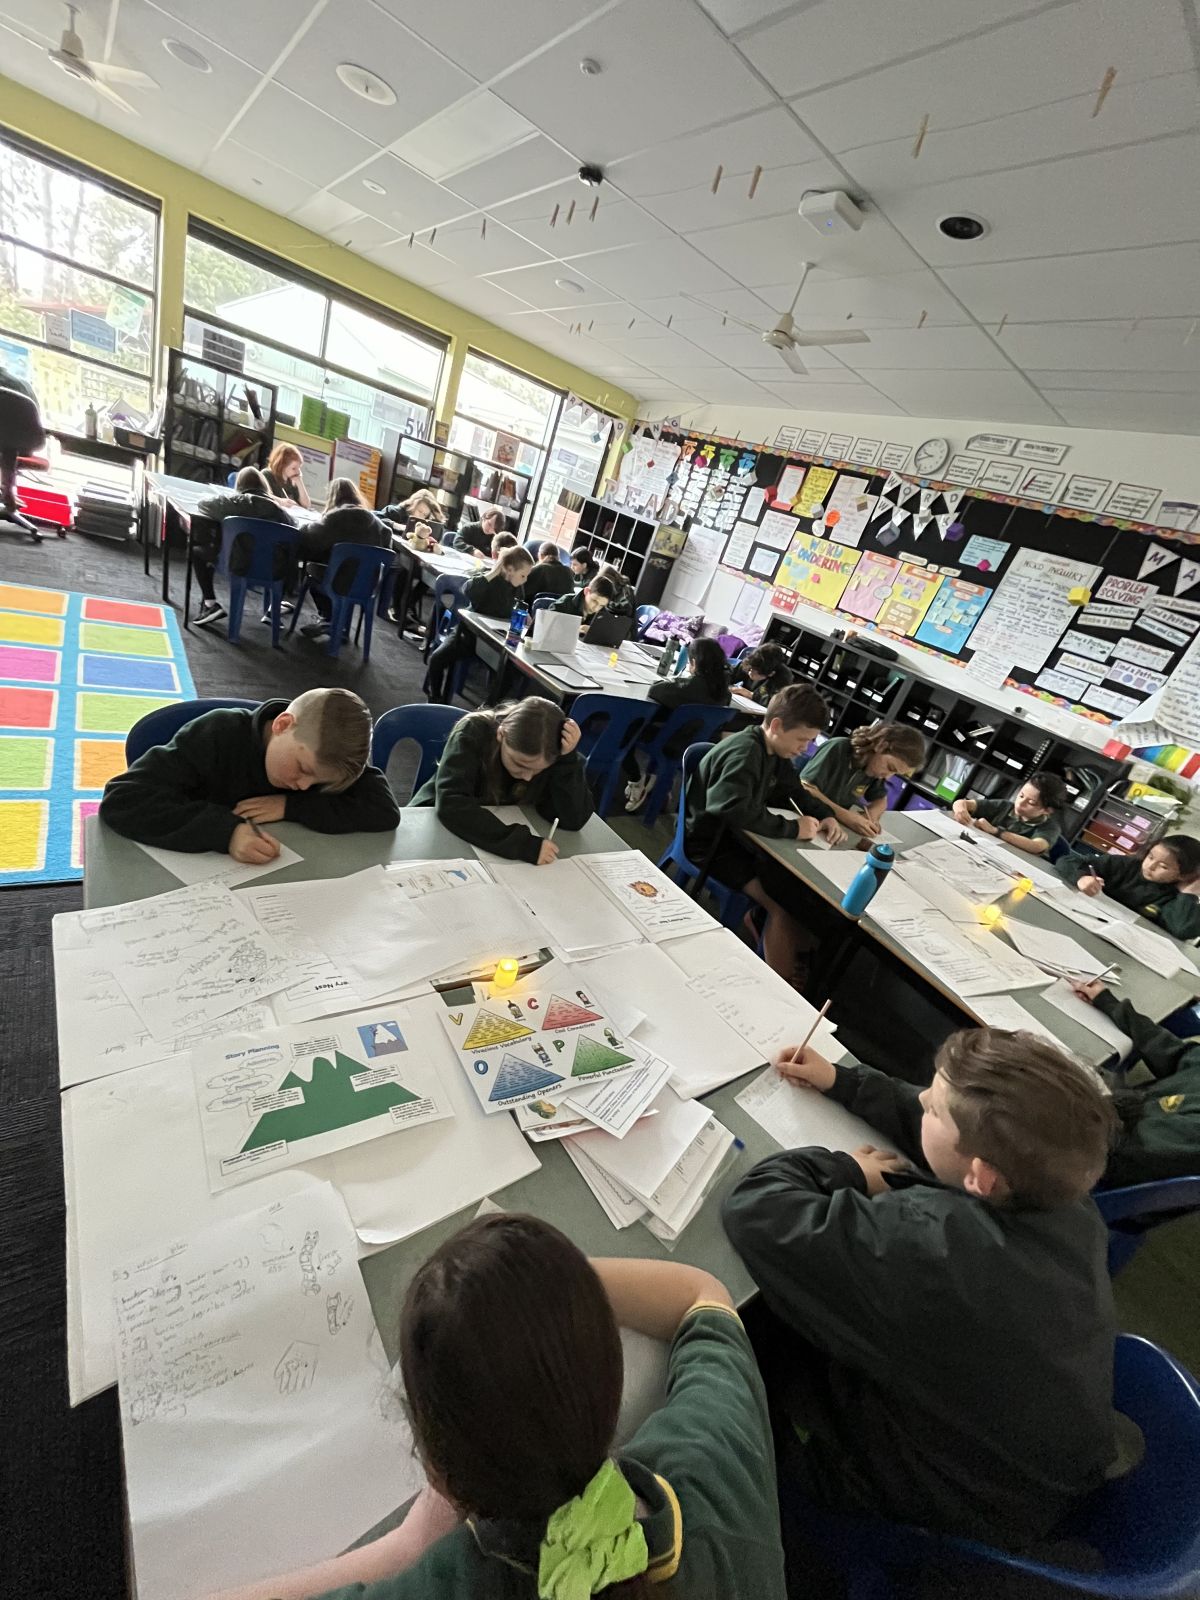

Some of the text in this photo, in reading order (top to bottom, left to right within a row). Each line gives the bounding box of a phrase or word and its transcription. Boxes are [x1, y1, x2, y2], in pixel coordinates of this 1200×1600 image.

[1105, 576, 1149, 596] PROBLEM
[1099, 587, 1143, 605] SOLVING
[1166, 614, 1196, 630] Pattern
[1135, 669, 1163, 683] Pattern
[526, 997, 540, 1010] C
[448, 1012, 464, 1026] V
[225, 1050, 246, 1060] Story
[247, 1043, 280, 1055] Planning
[552, 1039, 565, 1053] P
[473, 1059, 489, 1075] O
[578, 1073, 602, 1082] Powerful
[497, 1083, 563, 1106] Outstanding Openers
